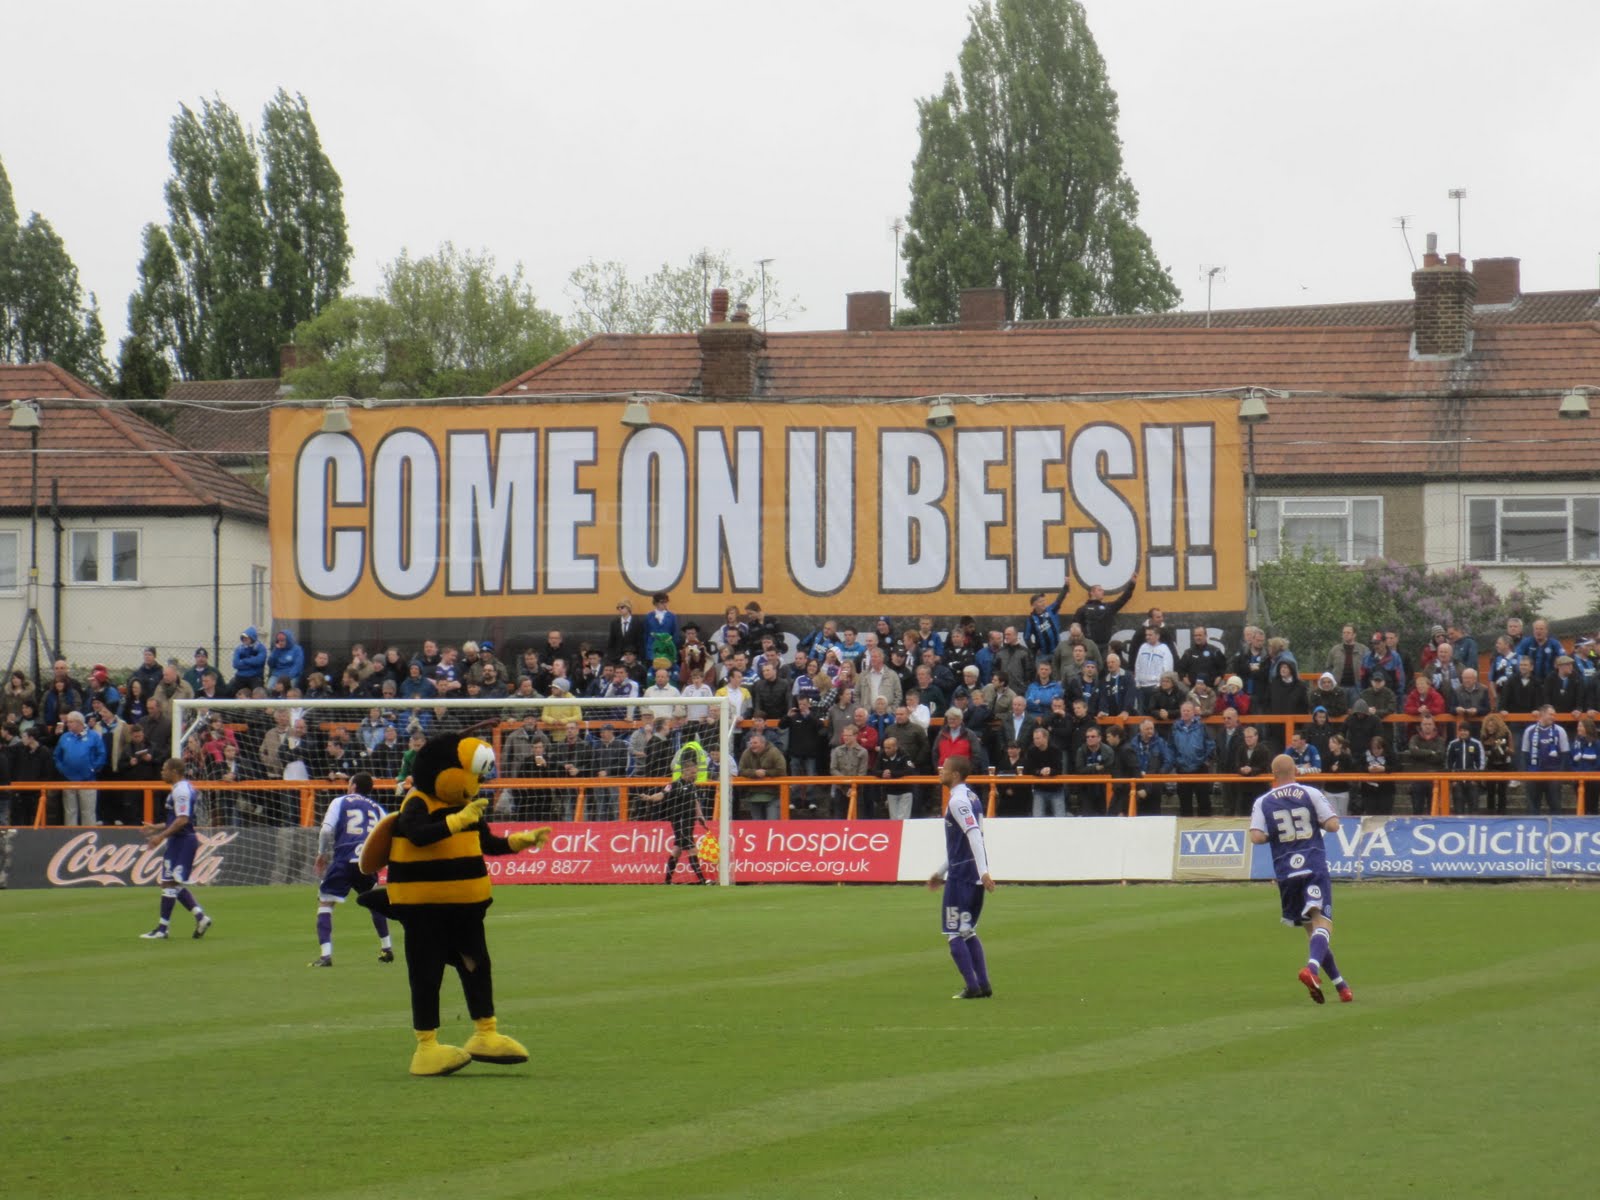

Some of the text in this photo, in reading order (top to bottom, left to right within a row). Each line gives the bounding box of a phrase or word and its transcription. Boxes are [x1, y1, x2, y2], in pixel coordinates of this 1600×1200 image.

[293, 420, 1217, 600] COME ON U BEES!!
[1272, 787, 1304, 800] TAYLOR
[346, 809, 379, 834] 23
[1273, 807, 1312, 843] 33
[551, 829, 600, 853] ark
[766, 827, 889, 857] hospice
[1184, 832, 1241, 853] YVA
[1319, 823, 1600, 857] VA Solicitors
[505, 861, 546, 876] 8449
[551, 860, 592, 874] 8877
[1369, 859, 1413, 873] 9898
